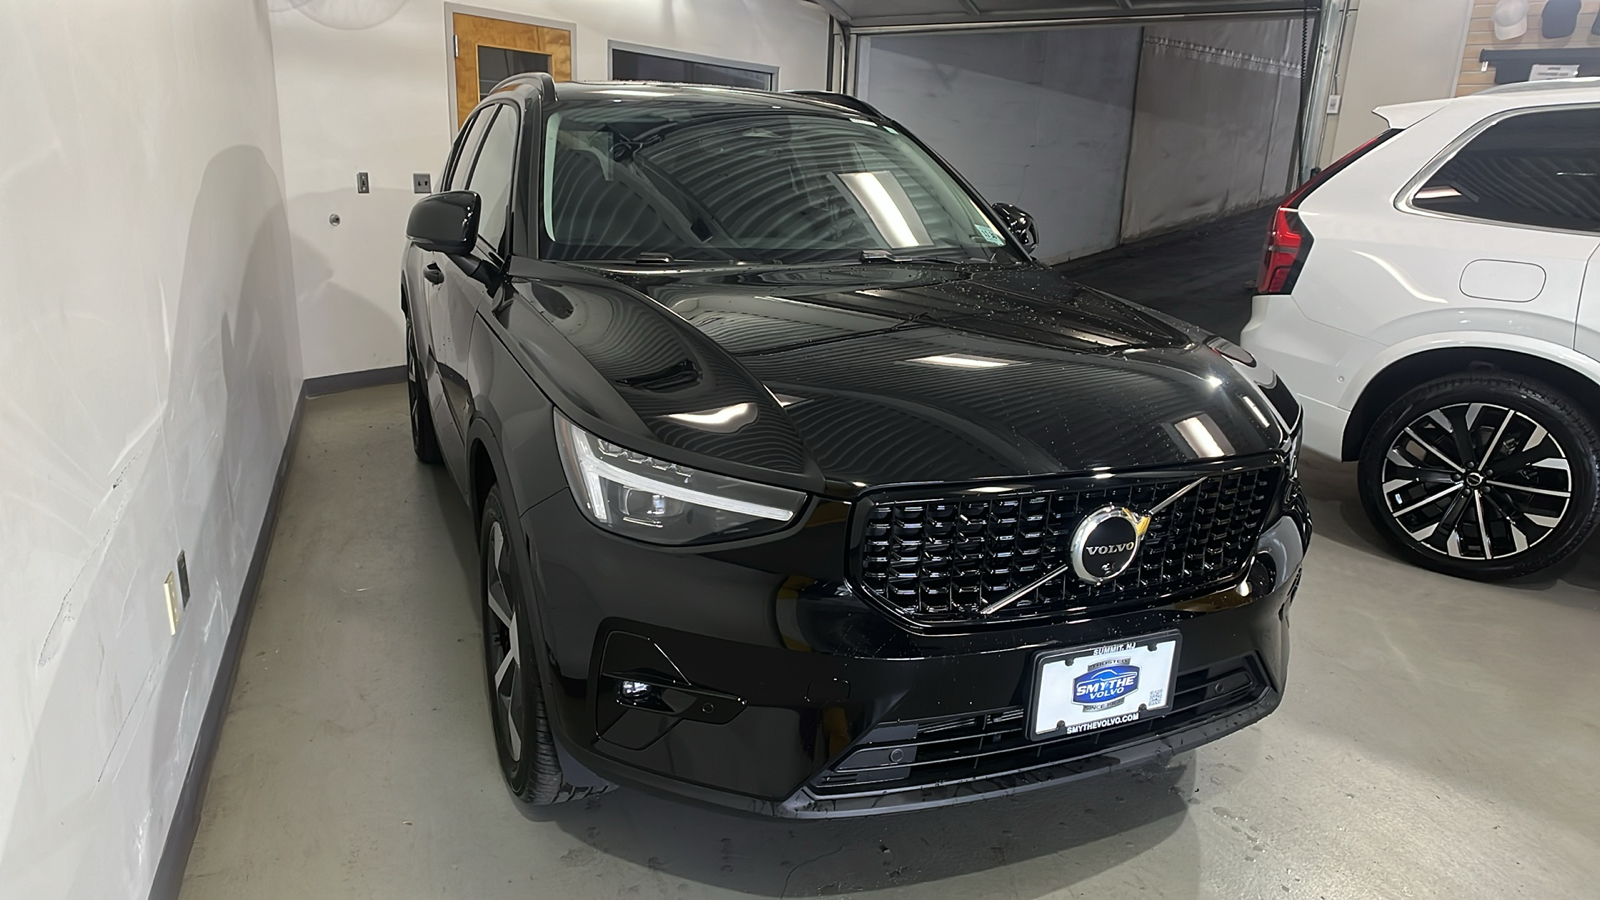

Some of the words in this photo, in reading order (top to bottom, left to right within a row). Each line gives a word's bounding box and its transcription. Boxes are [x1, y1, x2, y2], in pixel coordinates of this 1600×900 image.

[1086, 541, 1134, 556] VOLVO
[1126, 642, 1137, 650] NJ
[1076, 676, 1135, 696] SMYTHE
[1089, 686, 1125, 699] VOLVO
[1066, 712, 1139, 734] SMYTHEVOLVO.COM
